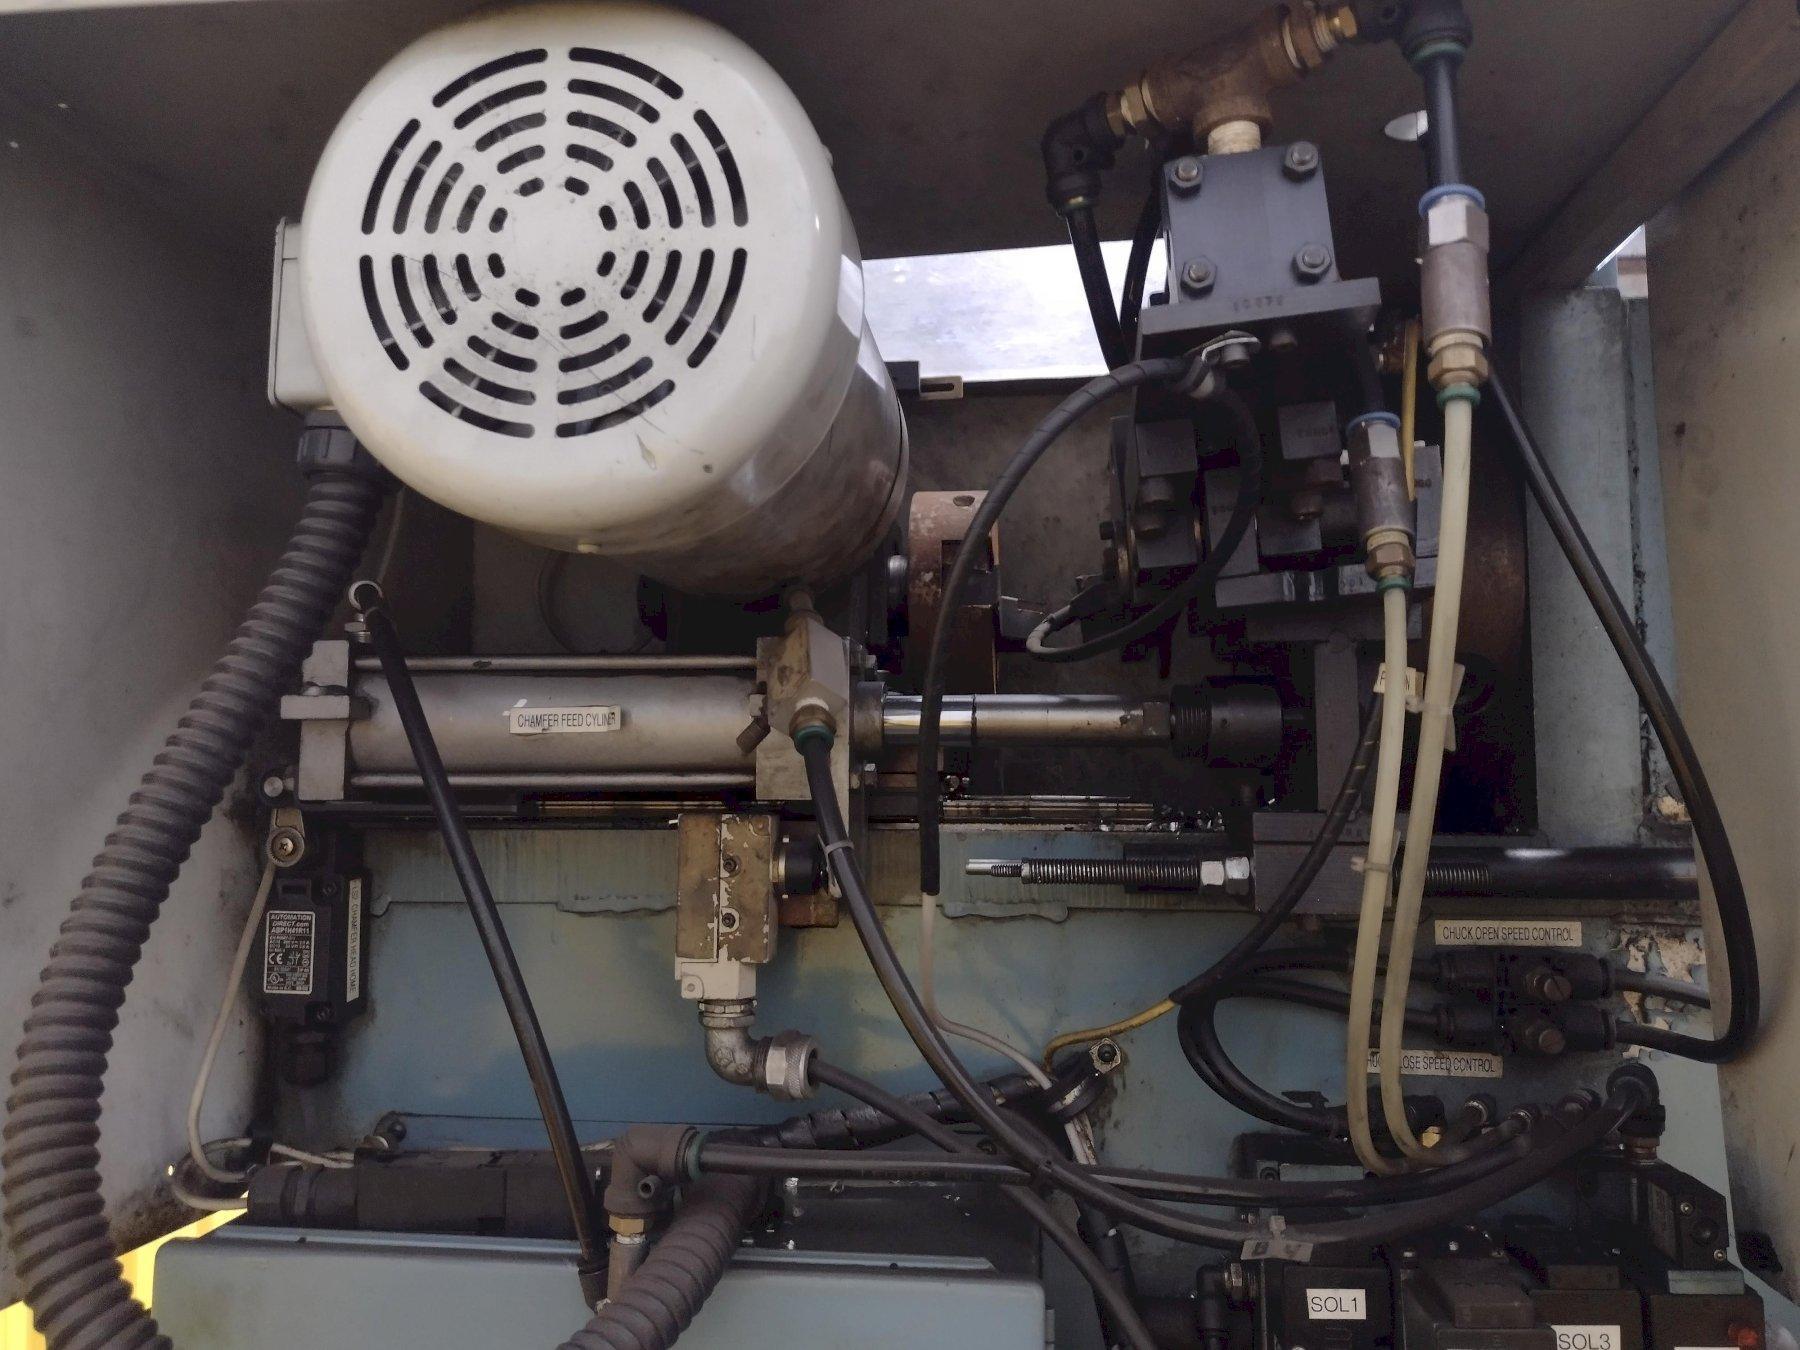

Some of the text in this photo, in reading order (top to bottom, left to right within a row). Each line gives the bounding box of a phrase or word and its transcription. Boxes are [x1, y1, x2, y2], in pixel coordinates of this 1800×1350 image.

[517, 713, 559, 728] CHAMFER
[561, 713, 584, 727] FEED
[350, 903, 359, 943] CHAMFER
[1442, 926, 1574, 941] CHUCK OPEN SPEED CONTROL
[349, 945, 357, 967] HEAD
[349, 969, 357, 992] HOME
[1400, 1055, 1421, 1070] OSE
[1422, 1055, 1452, 1071] SPEED
[1453, 1057, 1496, 1073] CONTROL
[1310, 1295, 1359, 1313] SOL1
[1558, 1333, 1611, 1350] SOL3
